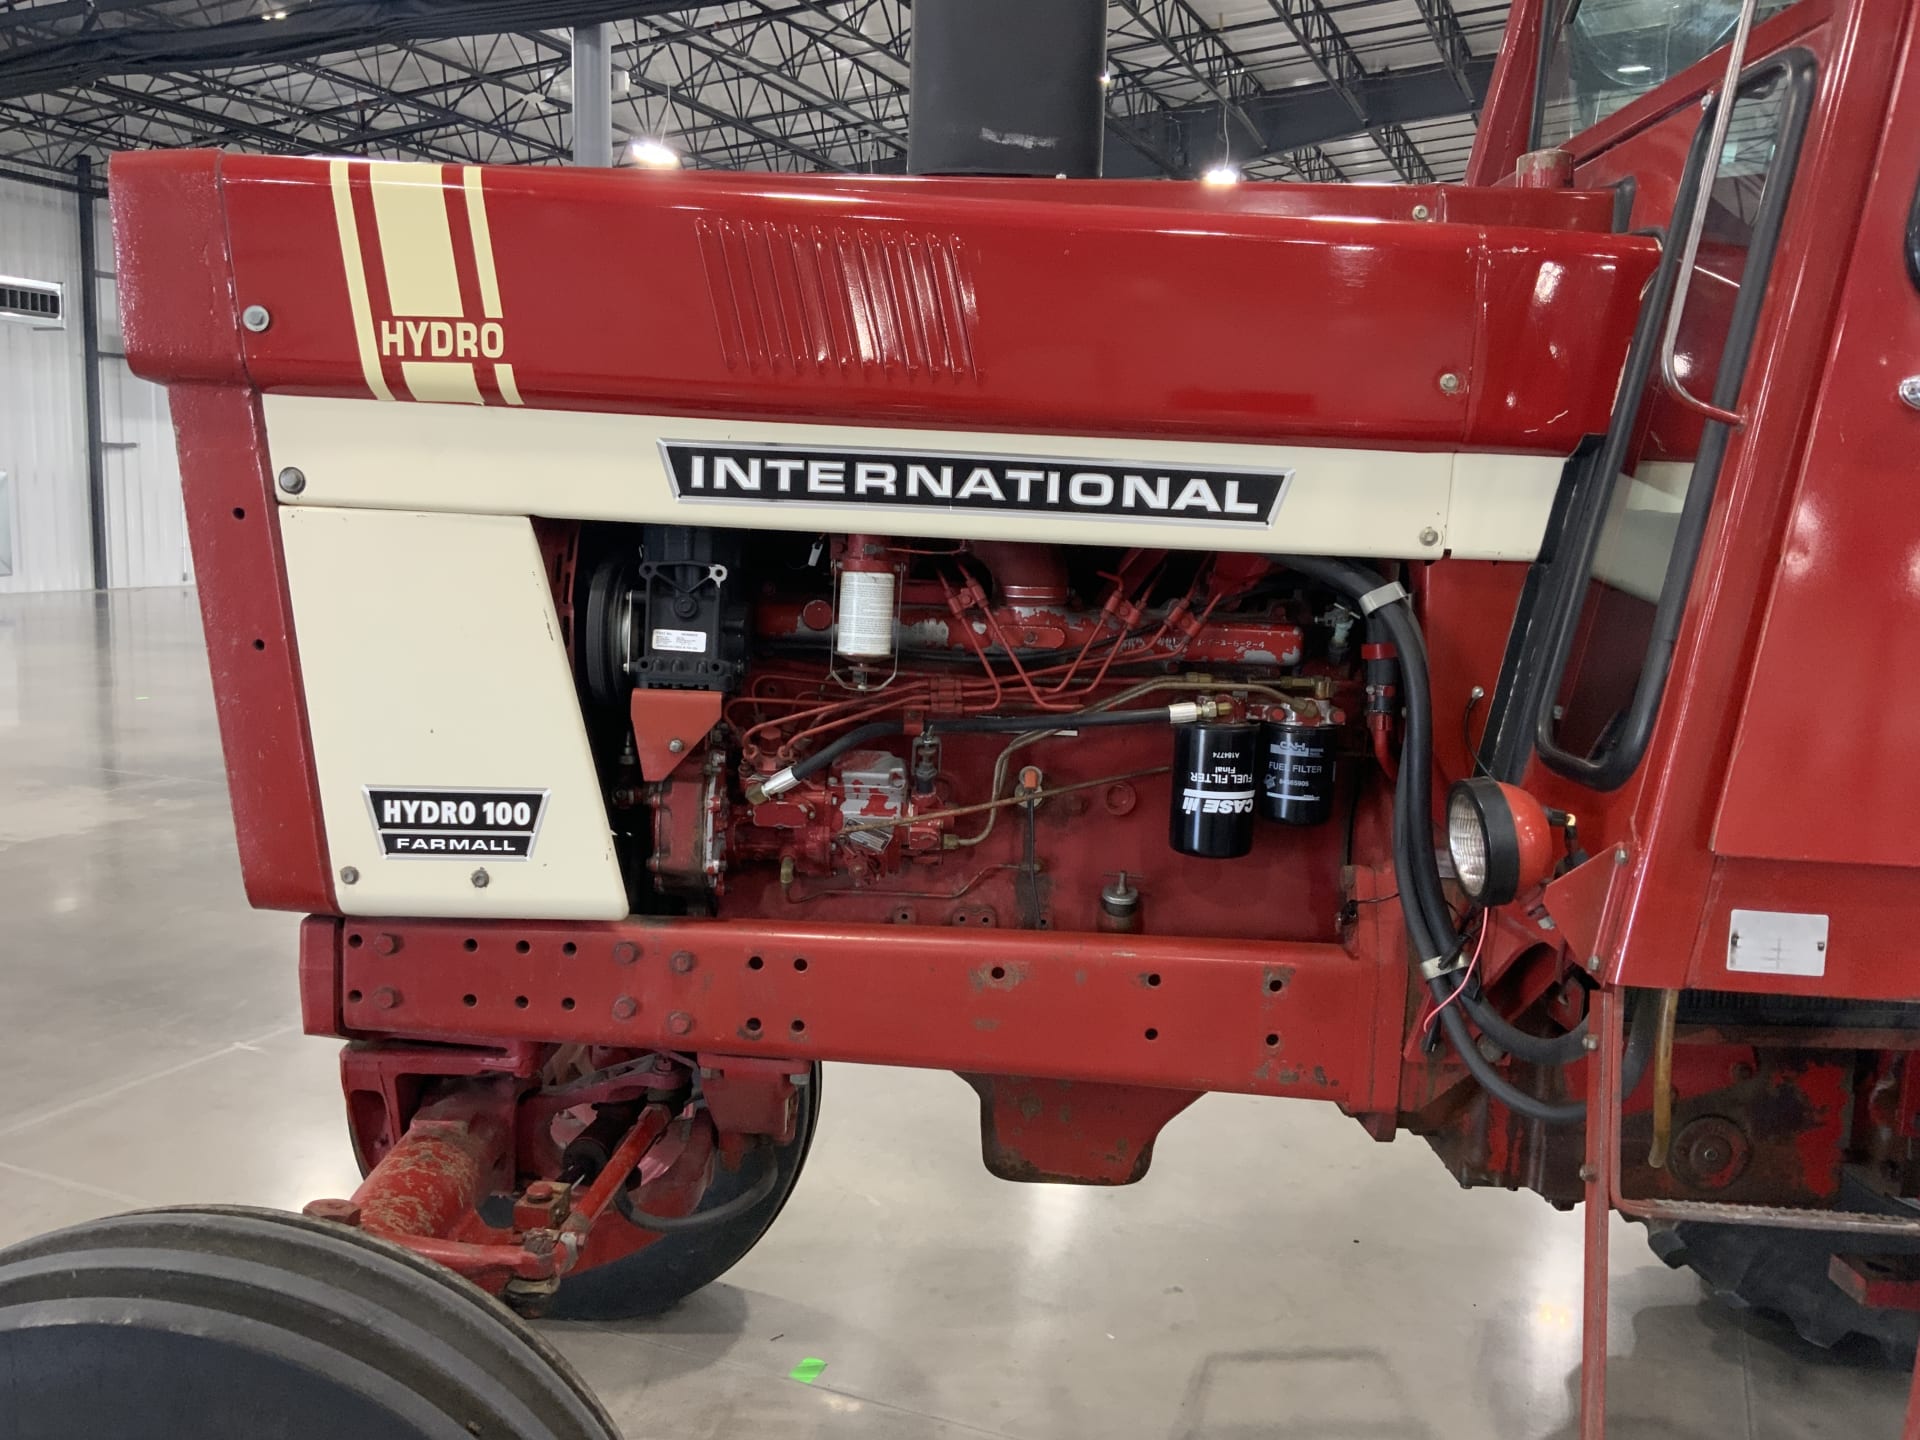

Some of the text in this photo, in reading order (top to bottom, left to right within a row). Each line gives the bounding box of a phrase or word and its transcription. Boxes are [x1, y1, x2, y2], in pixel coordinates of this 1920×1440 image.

[381, 320, 504, 359] HYDRO
[690, 455, 1260, 515] INTERNATIONAL
[1215, 766, 1236, 774] Final
[1292, 764, 1322, 773] FILTER
[1190, 771, 1253, 784] FUEL FILTER
[383, 799, 531, 826] HYDRO 100
[1202, 798, 1254, 814] CASE
[396, 838, 516, 851] FARMALL
